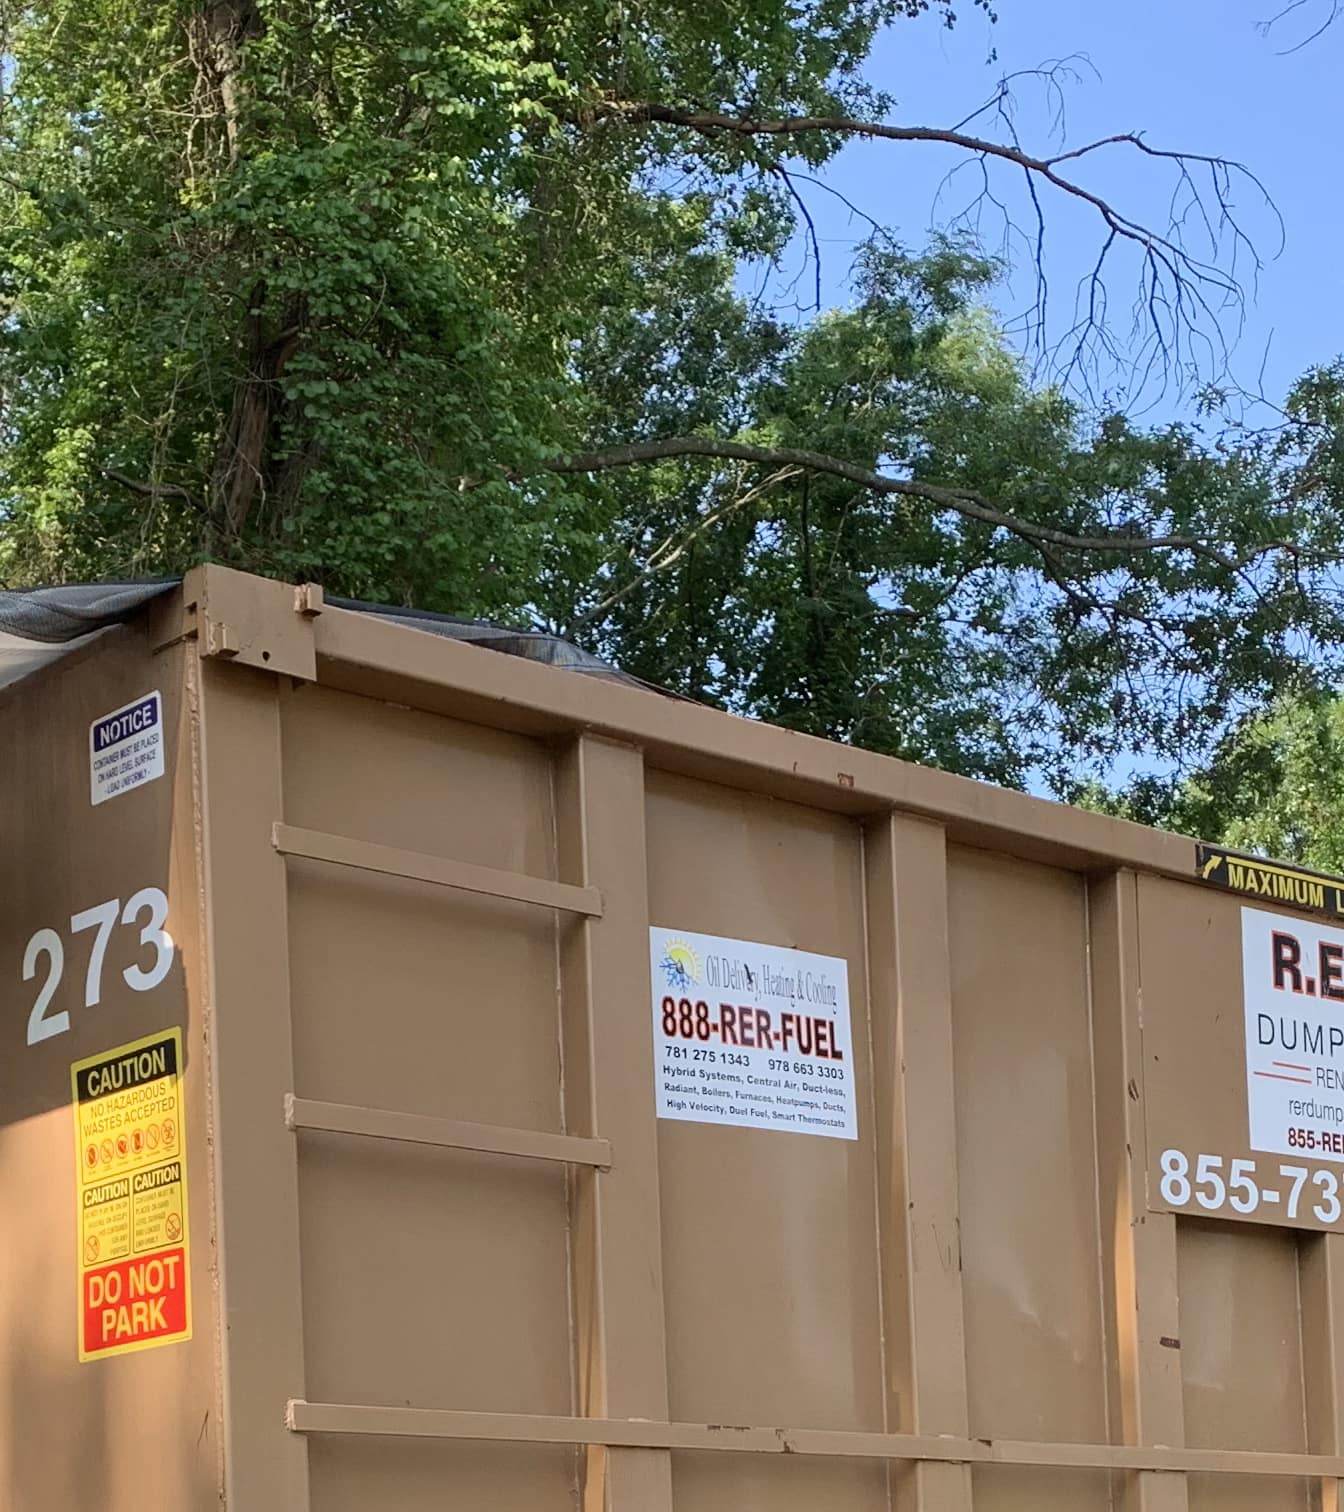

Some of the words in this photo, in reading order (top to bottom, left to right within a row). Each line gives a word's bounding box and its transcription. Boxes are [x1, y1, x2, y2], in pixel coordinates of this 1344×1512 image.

[99, 704, 153, 746] NOTICE
[1227, 863, 1324, 909] MAXIMUM
[22, 887, 175, 1046] 273
[706, 955, 720, 987] Oil
[797, 970, 804, 1000] &
[661, 996, 844, 1061] 888-RER-FUEL
[87, 1046, 166, 1096] CAUTION
[665, 1046, 687, 1059] 781
[693, 1049, 716, 1063] 275
[720, 1052, 750, 1067] 1343
[768, 1059, 790, 1072] 978
[793, 1062, 814, 1076] 663
[817, 1066, 844, 1080] 3303
[91, 1103, 104, 1118] NO
[107, 1082, 166, 1113] HAZARDOUS
[663, 1065, 696, 1077] Hybrid
[699, 1069, 744, 1085] Systems,
[747, 1075, 781, 1088] Central
[784, 1080, 800, 1092] Air,
[802, 1082, 846, 1098] Duct-less,
[664, 1082, 699, 1095] Radiant,
[702, 1087, 733, 1099] Boilers,
[735, 1090, 774, 1104] Furnaces,
[823, 1102, 846, 1114] Ducts,
[83, 1115, 122, 1136] WASTES
[123, 1096, 175, 1124] ACCEPTED
[667, 1099, 687, 1111] High
[689, 1101, 727, 1115] Velocity,
[750, 1108, 770, 1120] Fuel,
[772, 1110, 796, 1121] Smart
[798, 1114, 845, 1128] Thermostats
[84, 1180, 128, 1207] CAUTION
[134, 1164, 180, 1192] CAUTION
[88, 1269, 122, 1309] DO
[129, 1255, 180, 1299] NOT
[102, 1295, 168, 1342] PARK
